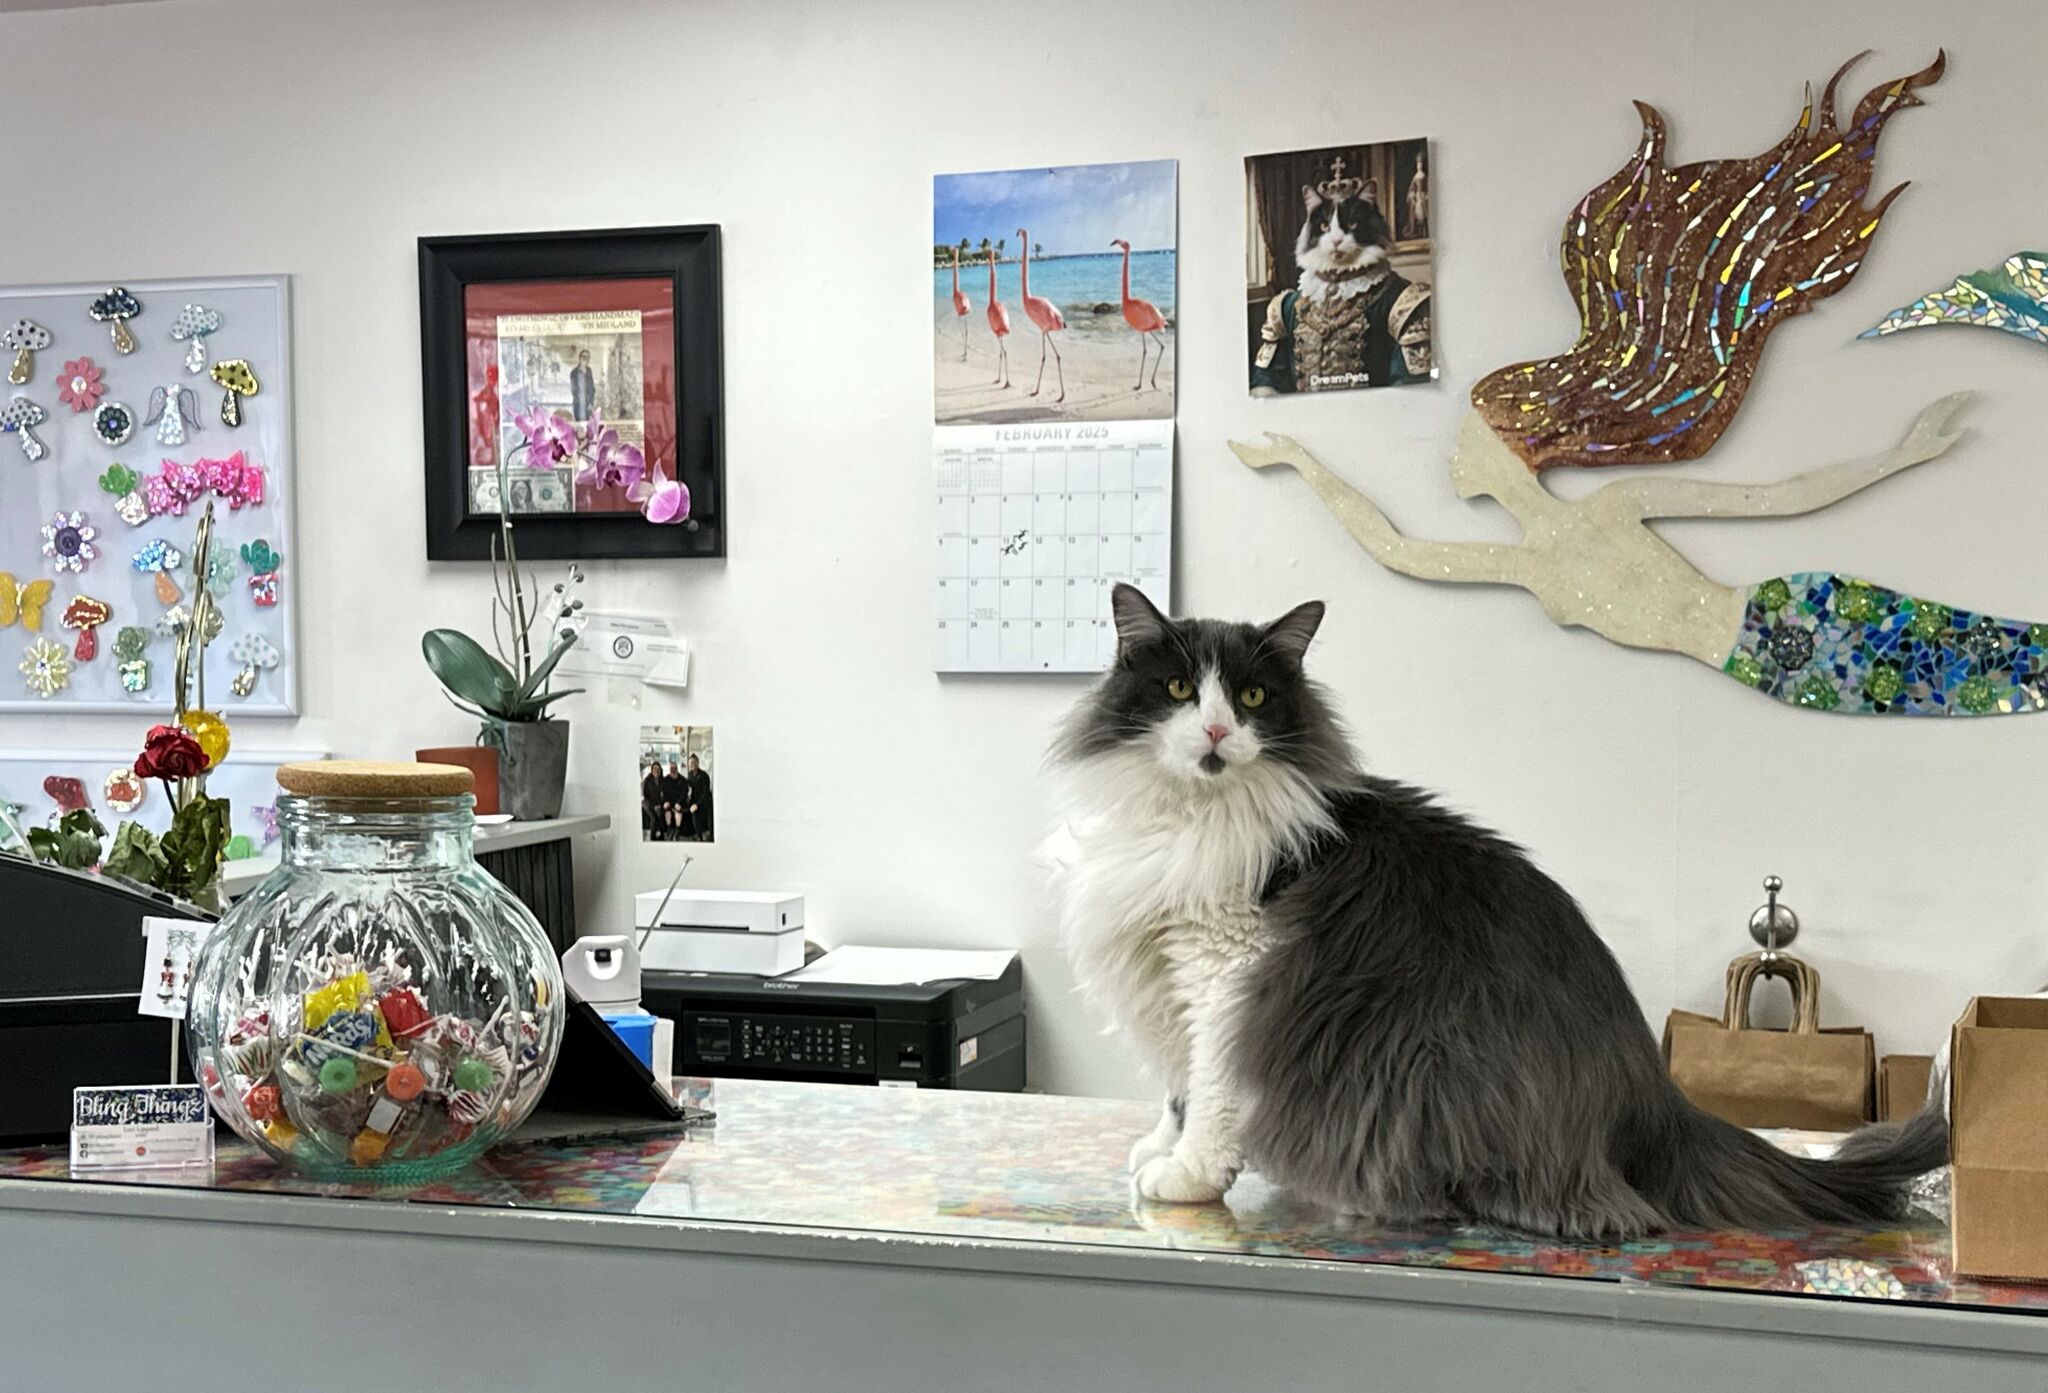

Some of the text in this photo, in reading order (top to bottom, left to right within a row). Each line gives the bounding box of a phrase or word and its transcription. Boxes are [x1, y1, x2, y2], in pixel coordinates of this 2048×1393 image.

[1310, 372, 1369, 386] DreamPets
[996, 426, 1109, 441] FEBRUARY 2025
[763, 982, 800, 990] brother
[77, 1091, 204, 1124] Bling Thingz
